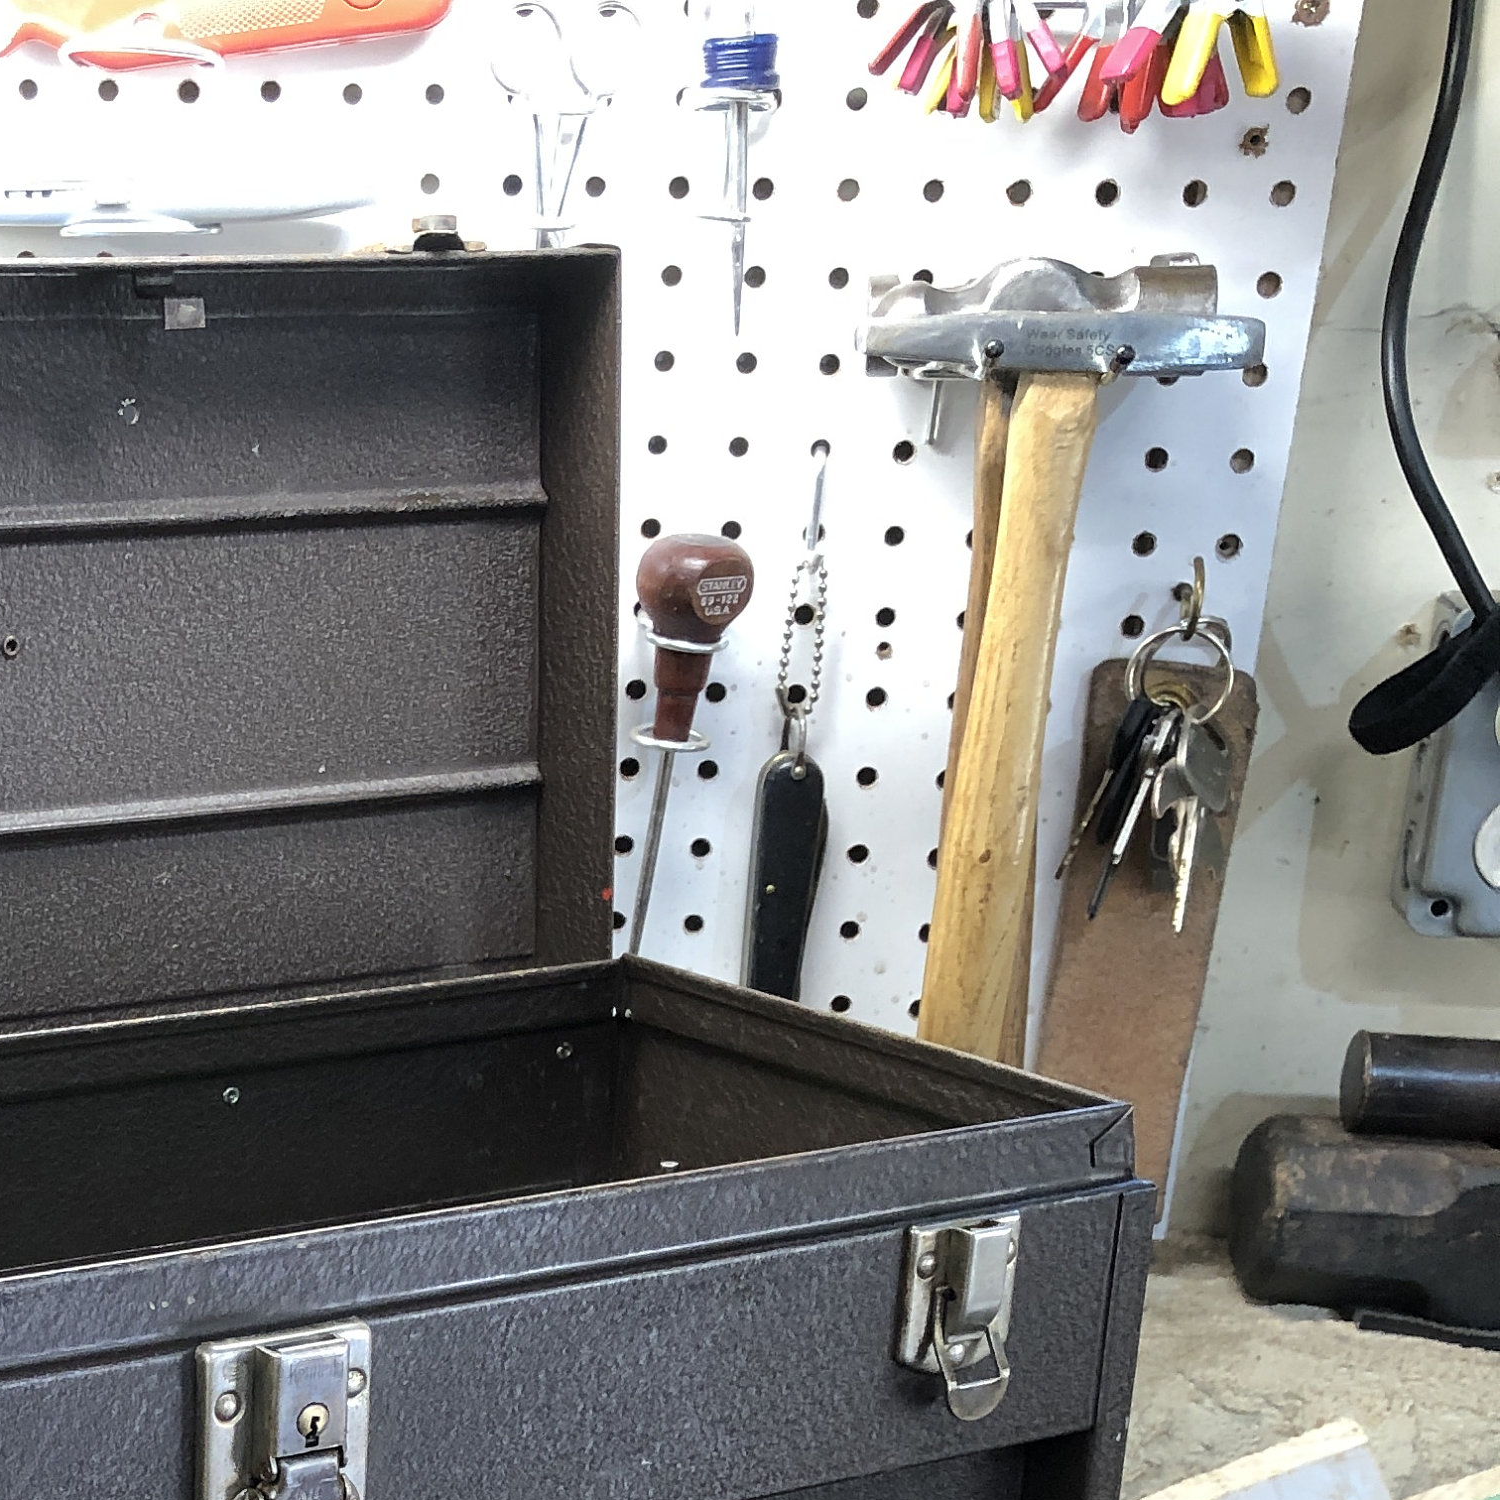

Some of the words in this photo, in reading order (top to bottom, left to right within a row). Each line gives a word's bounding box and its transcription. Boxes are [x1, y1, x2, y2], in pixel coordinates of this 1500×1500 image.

[1027, 328, 1062, 339] Wear
[1066, 327, 1112, 343] Safety
[701, 579, 743, 592] STANLEY
